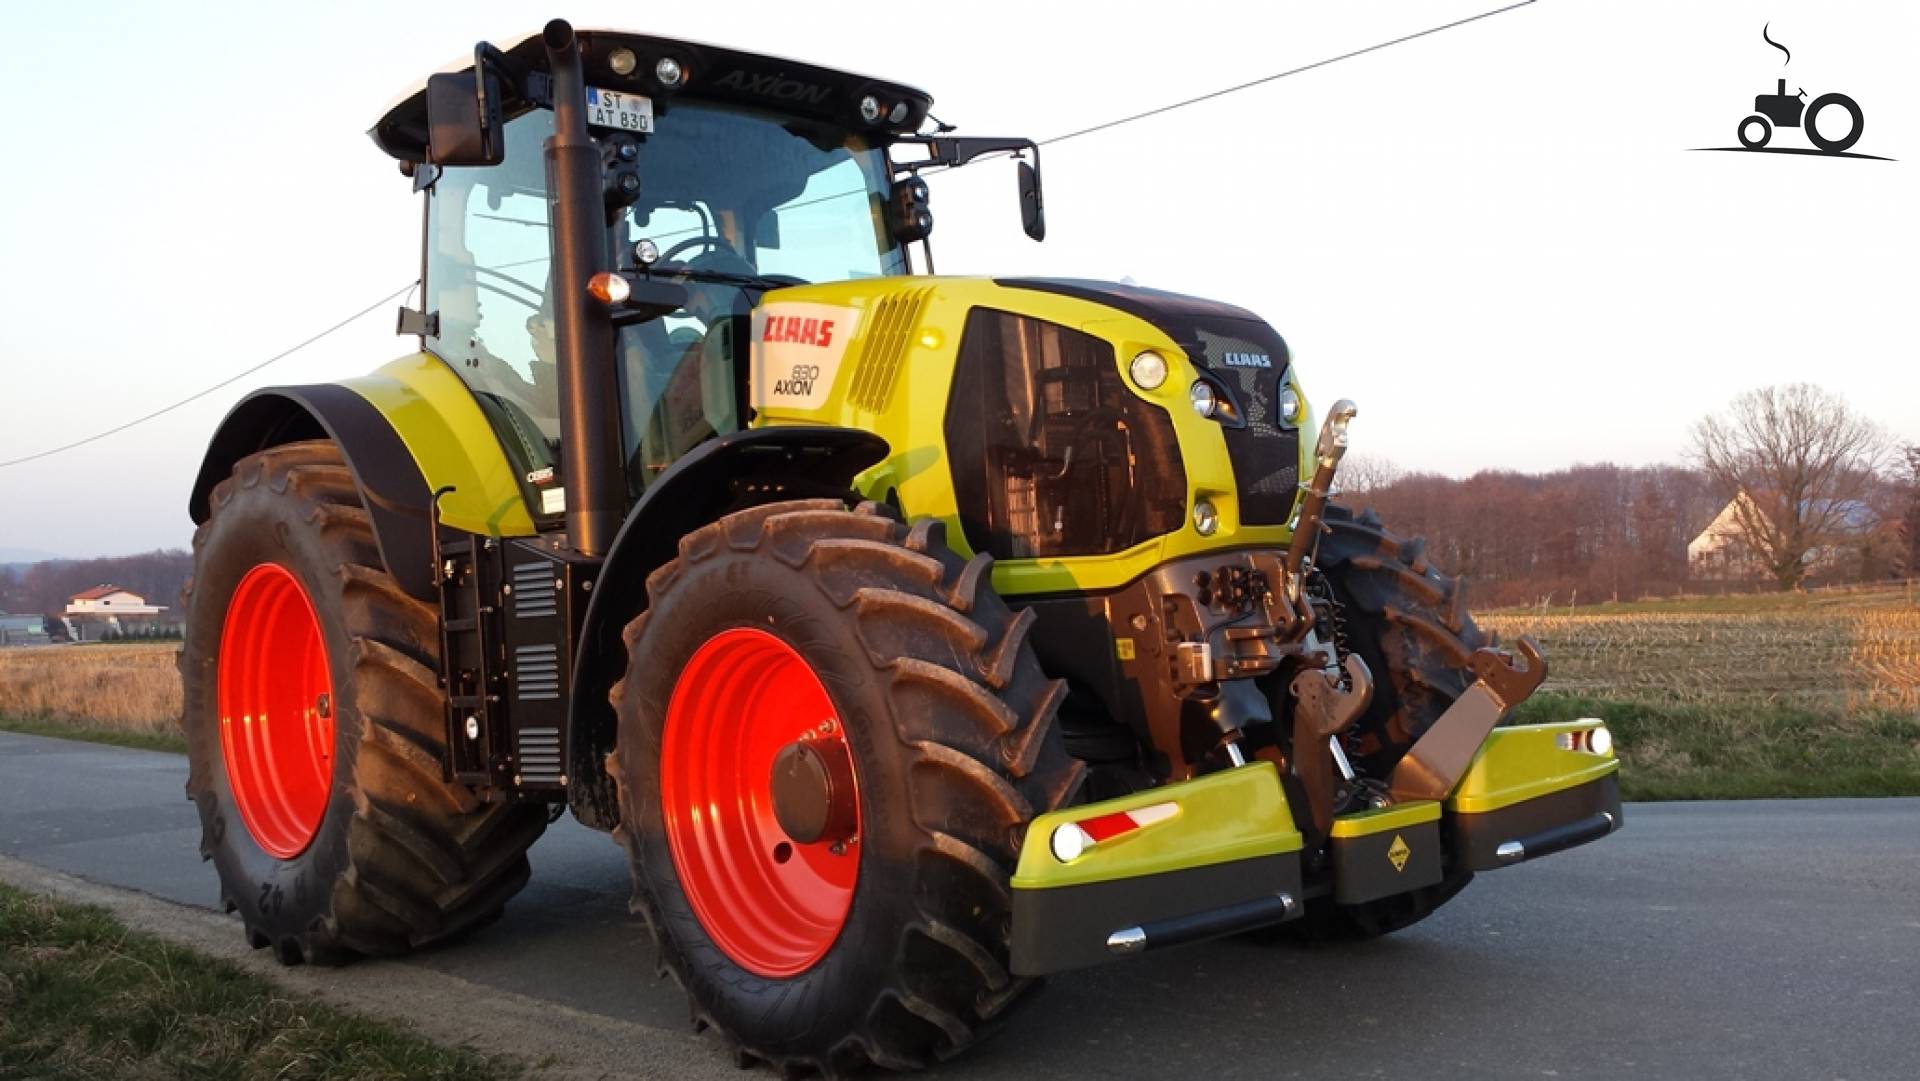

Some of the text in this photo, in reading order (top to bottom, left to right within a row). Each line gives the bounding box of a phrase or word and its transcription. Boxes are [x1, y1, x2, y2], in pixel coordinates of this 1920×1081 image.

[603, 92, 621, 109] ST
[597, 108, 648, 130] AT 830
[763, 316, 834, 347] CLAAS
[1225, 353, 1272, 368] CLAAS
[792, 365, 819, 381] 830
[774, 380, 814, 396] AXION
